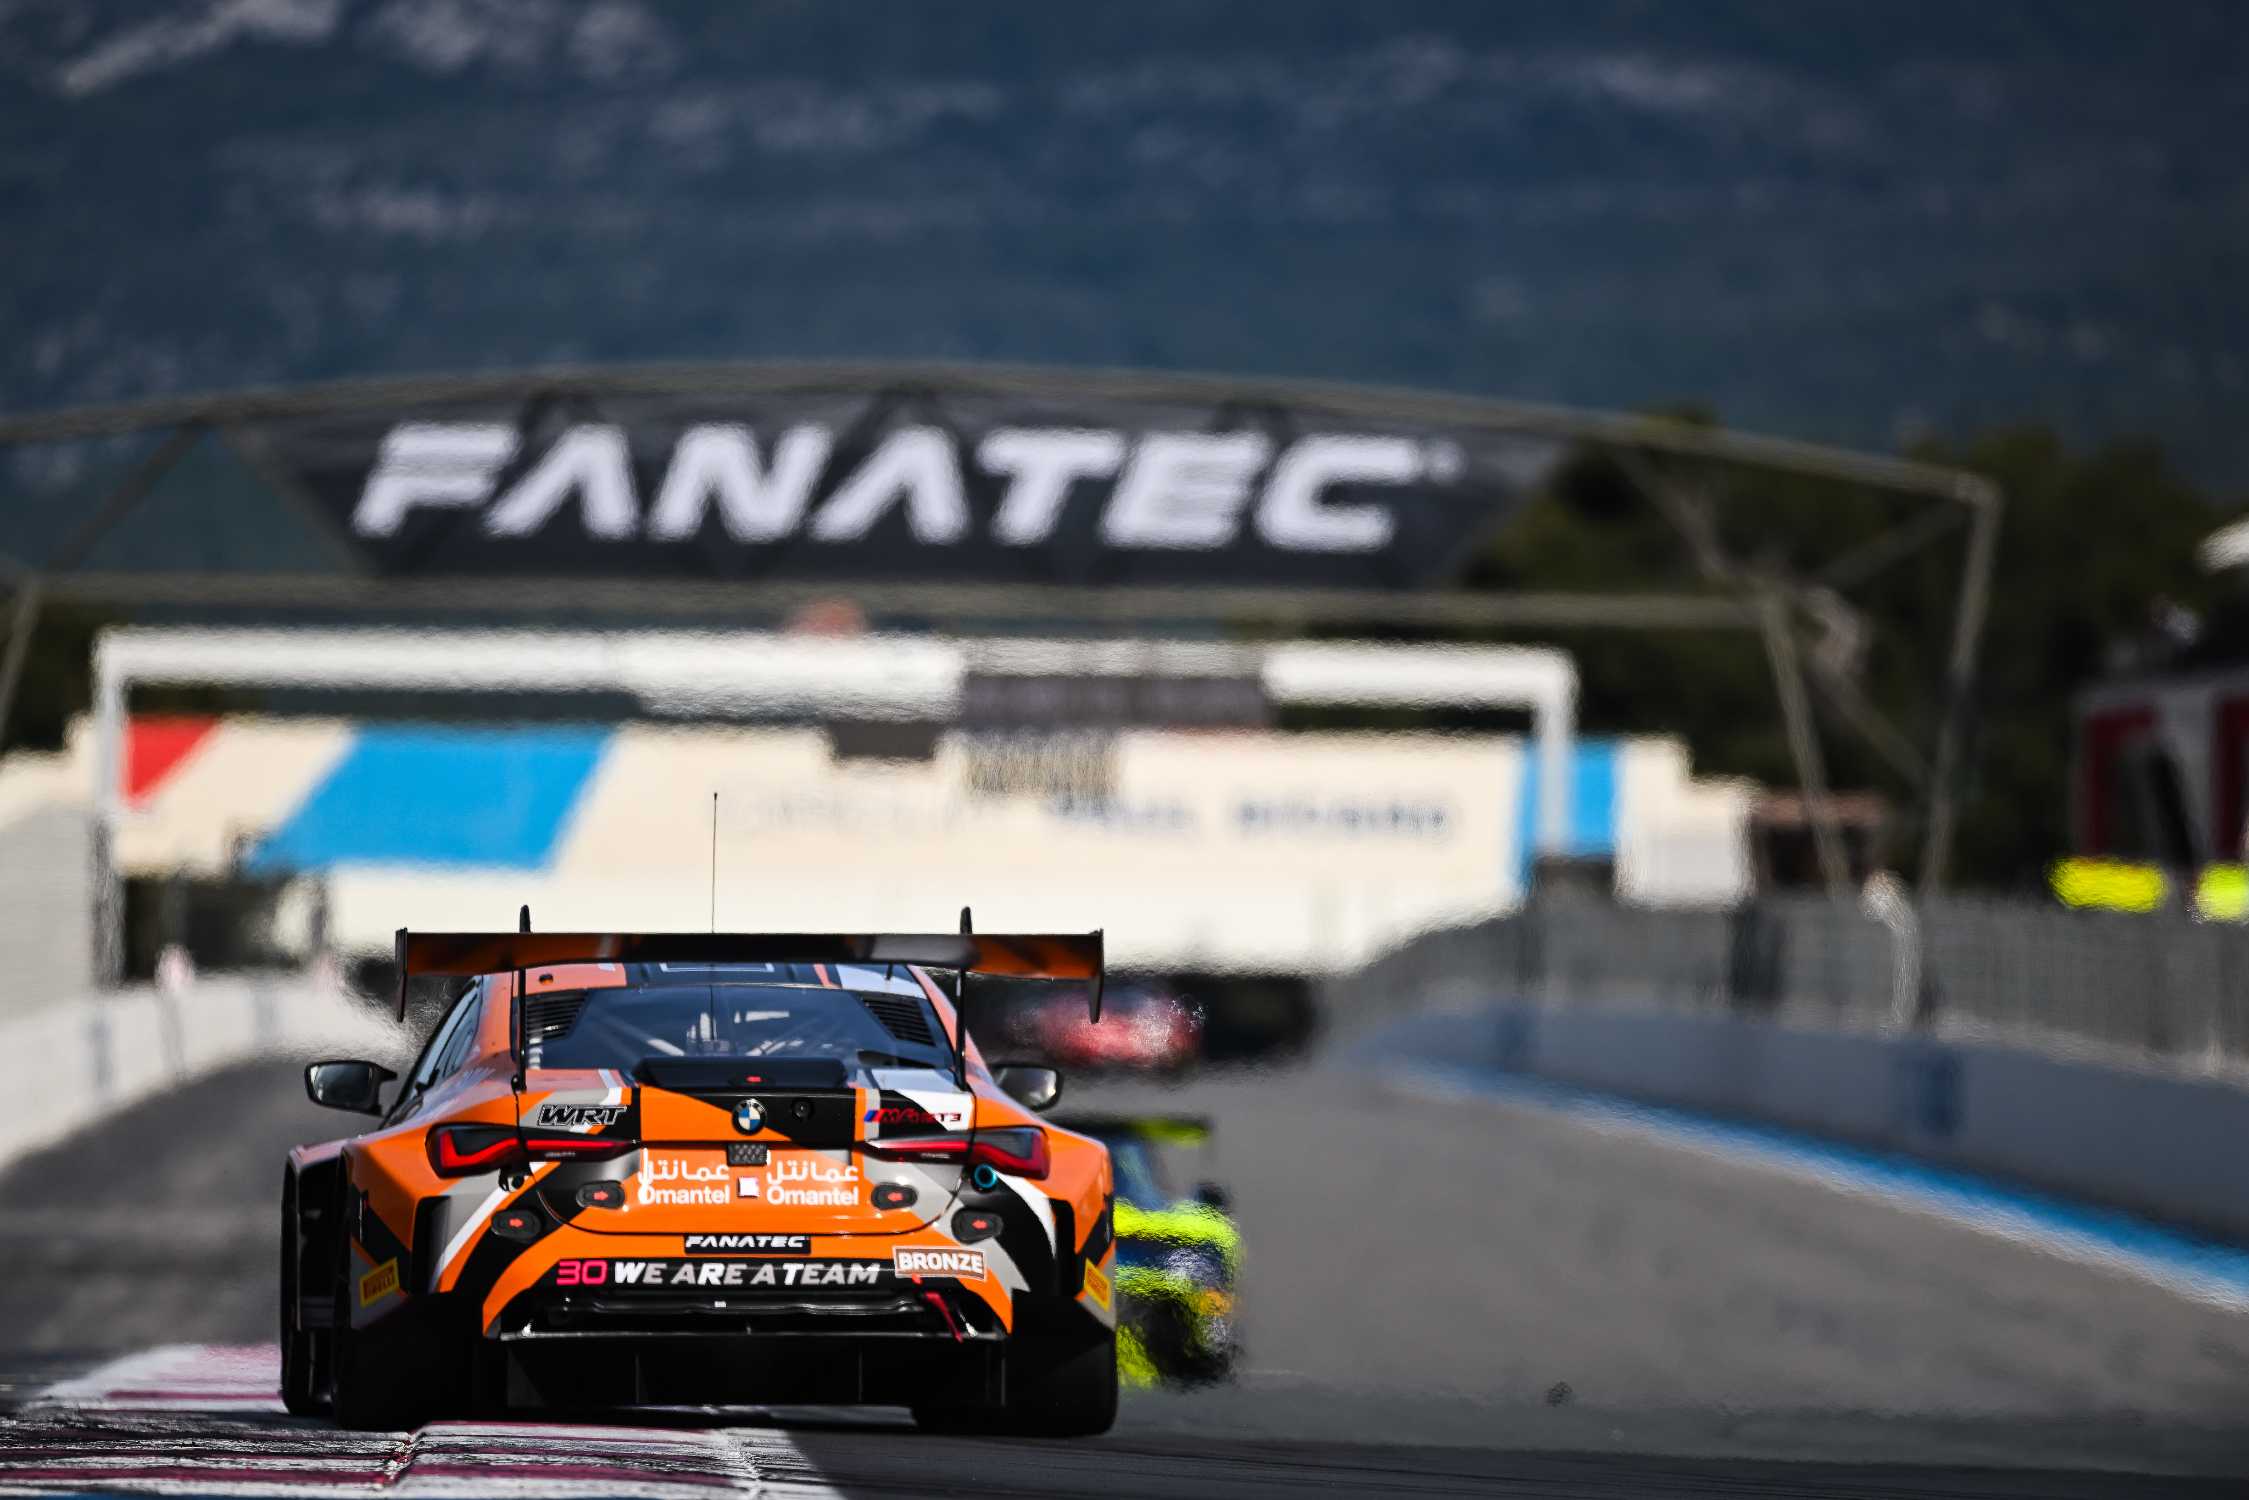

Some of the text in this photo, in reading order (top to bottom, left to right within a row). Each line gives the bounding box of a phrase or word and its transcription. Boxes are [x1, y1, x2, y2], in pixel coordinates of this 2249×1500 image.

[352, 422, 1420, 552] FANATEC
[538, 1104, 628, 1127] WRT
[638, 1184, 730, 1205] Omantel
[767, 1185, 859, 1206] Omantel
[685, 1235, 807, 1248] FANATEC
[556, 1260, 881, 1286] 30 WE ARE A TEAM
[899, 1252, 984, 1273] BRONZE
